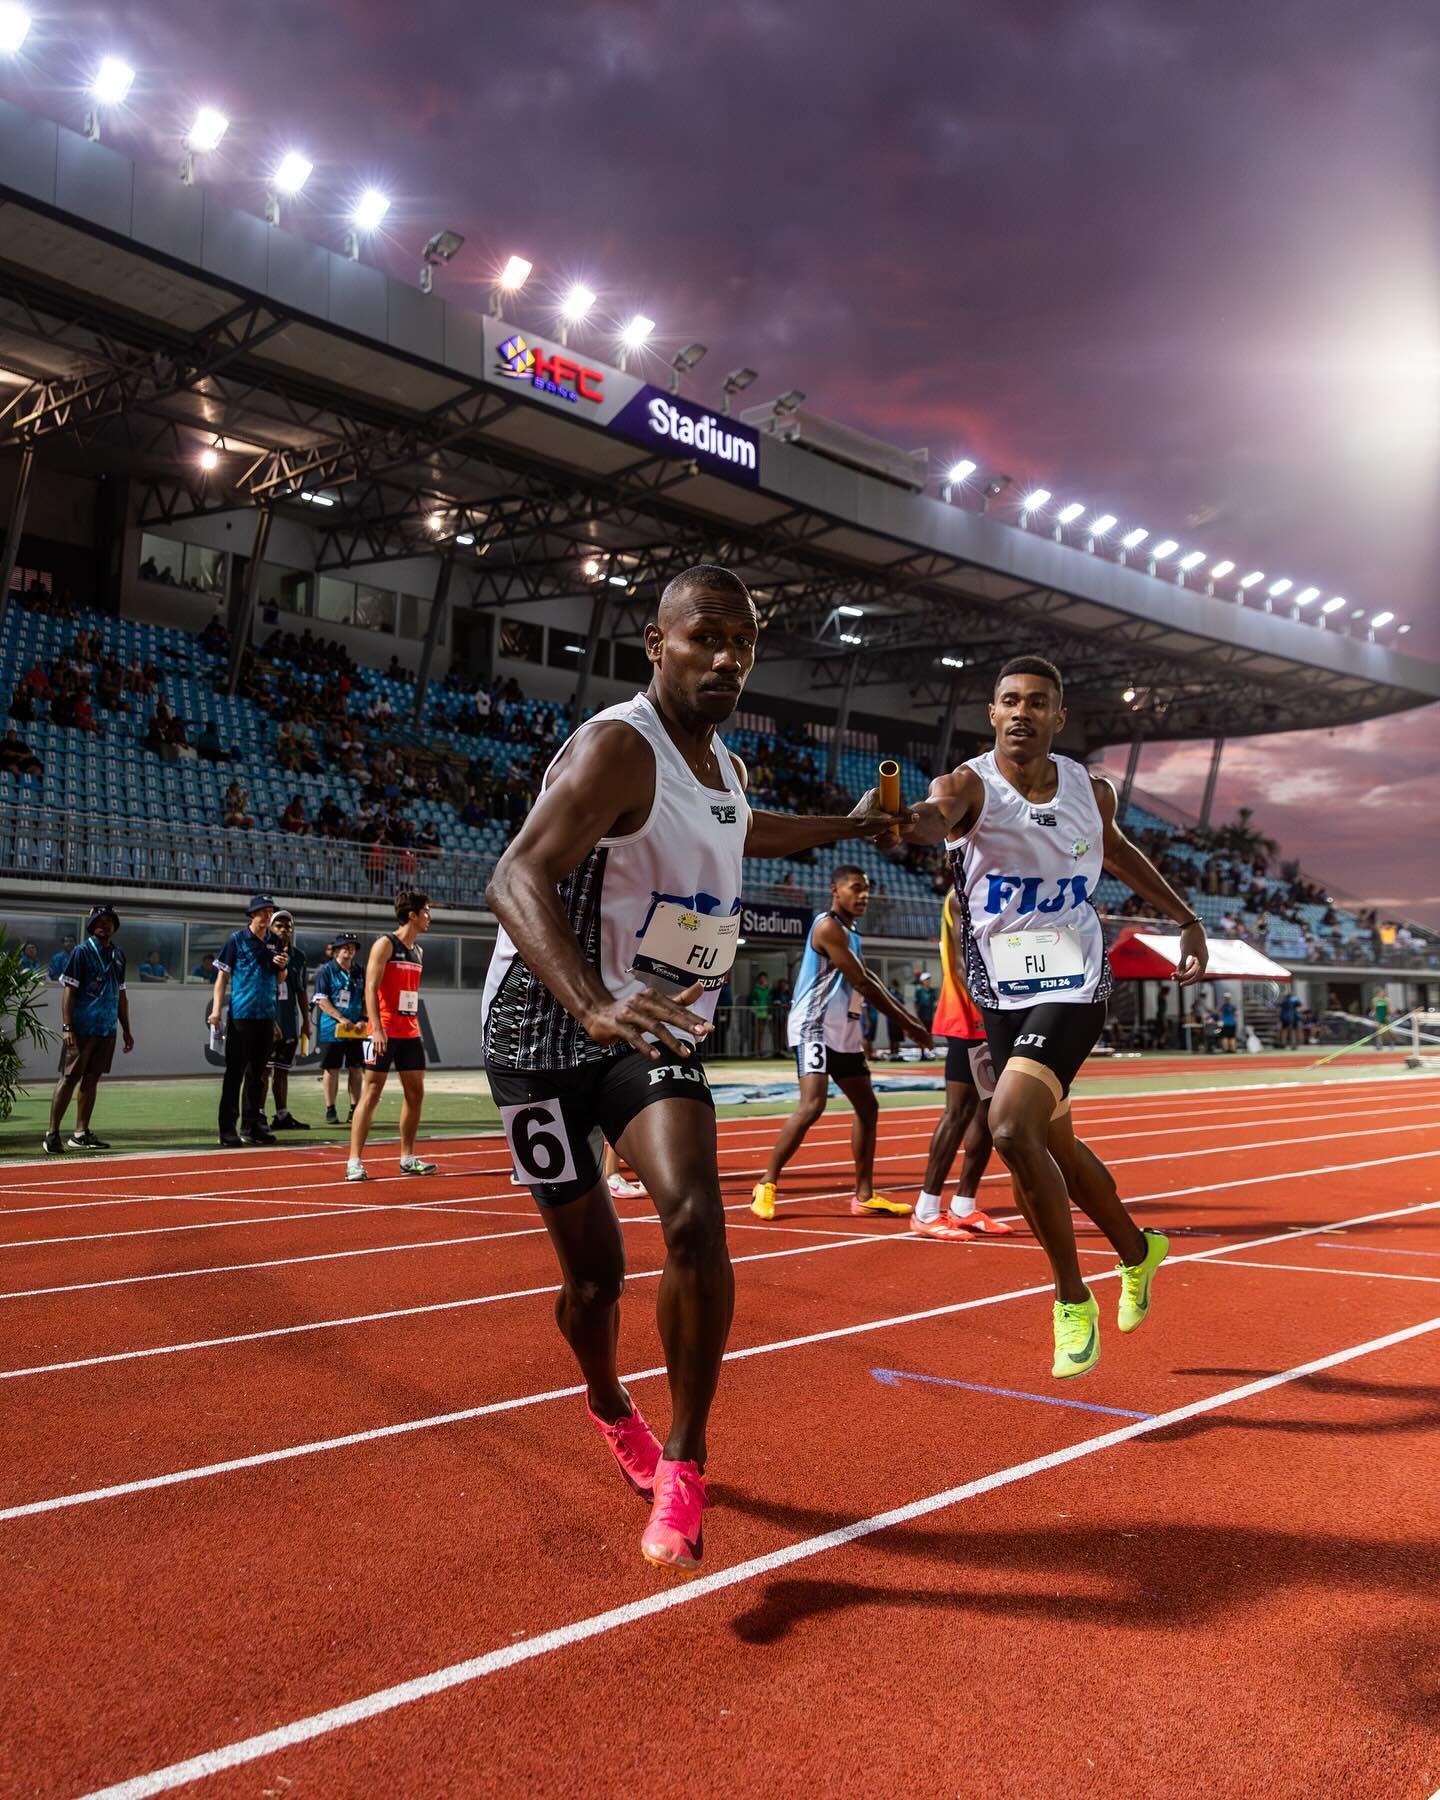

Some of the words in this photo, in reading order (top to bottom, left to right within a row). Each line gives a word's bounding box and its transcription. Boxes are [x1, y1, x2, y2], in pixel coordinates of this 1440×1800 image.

[534, 347, 604, 404] HFC
[648, 397, 757, 469] Stadium
[984, 873, 1089, 916] FIJI
[743, 908, 802, 934] Stadium
[686, 944, 719, 970] FIJ
[1025, 954, 1046, 973] FIJ
[1040, 979, 1057, 989] FIJI
[1058, 978, 1071, 987] 24
[808, 1043, 824, 1070] 3
[511, 1106, 566, 1180] 6
